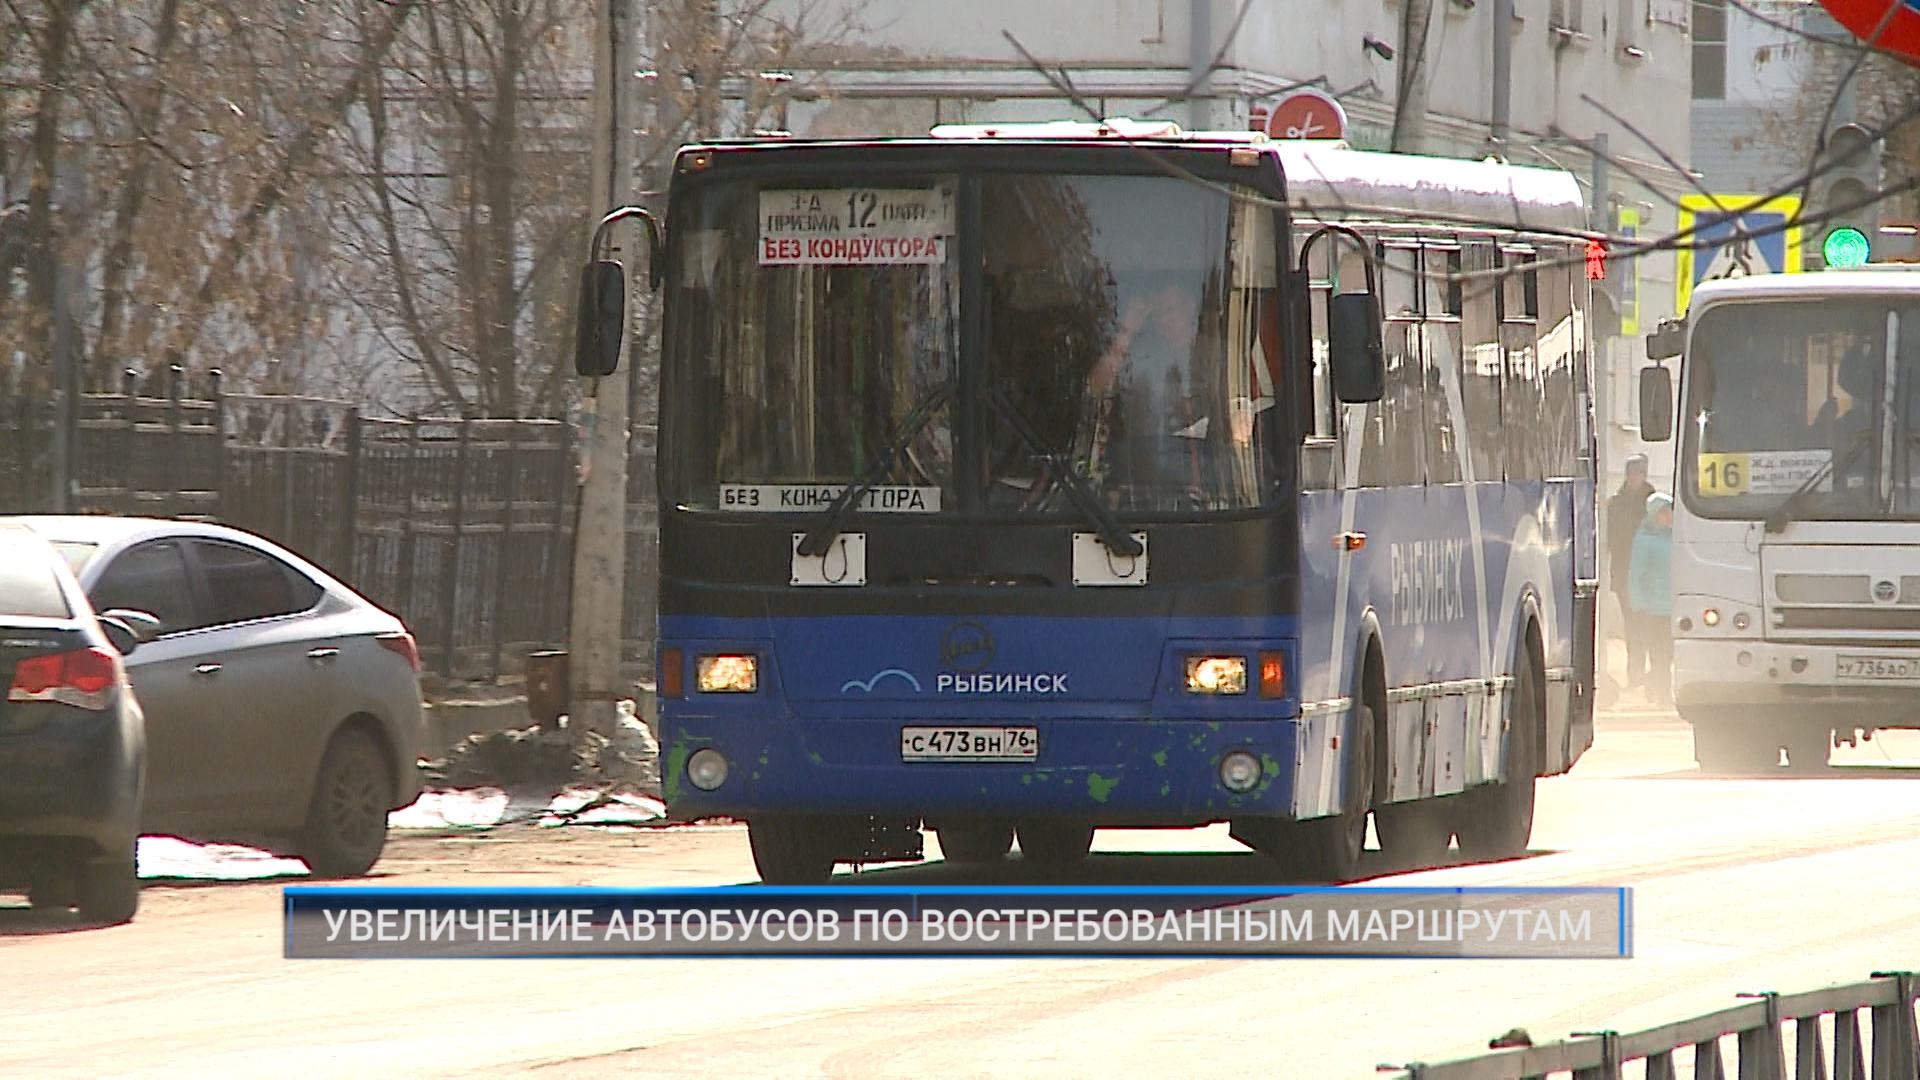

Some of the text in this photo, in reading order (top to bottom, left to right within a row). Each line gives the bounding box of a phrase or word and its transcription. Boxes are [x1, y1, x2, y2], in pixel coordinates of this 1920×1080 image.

[847, 191, 878, 229] 12
[767, 214, 841, 232] ПРИЗМА
[765, 237, 938, 261] БЕЗ КОНДУКТОРА
[1704, 461, 1740, 488] 16
[724, 488, 760, 505] БЕЗ
[1391, 537, 1464, 626] РЫБИНСК
[937, 674, 1068, 693] РЫБИНСК
[1007, 731, 1029, 747] 76
